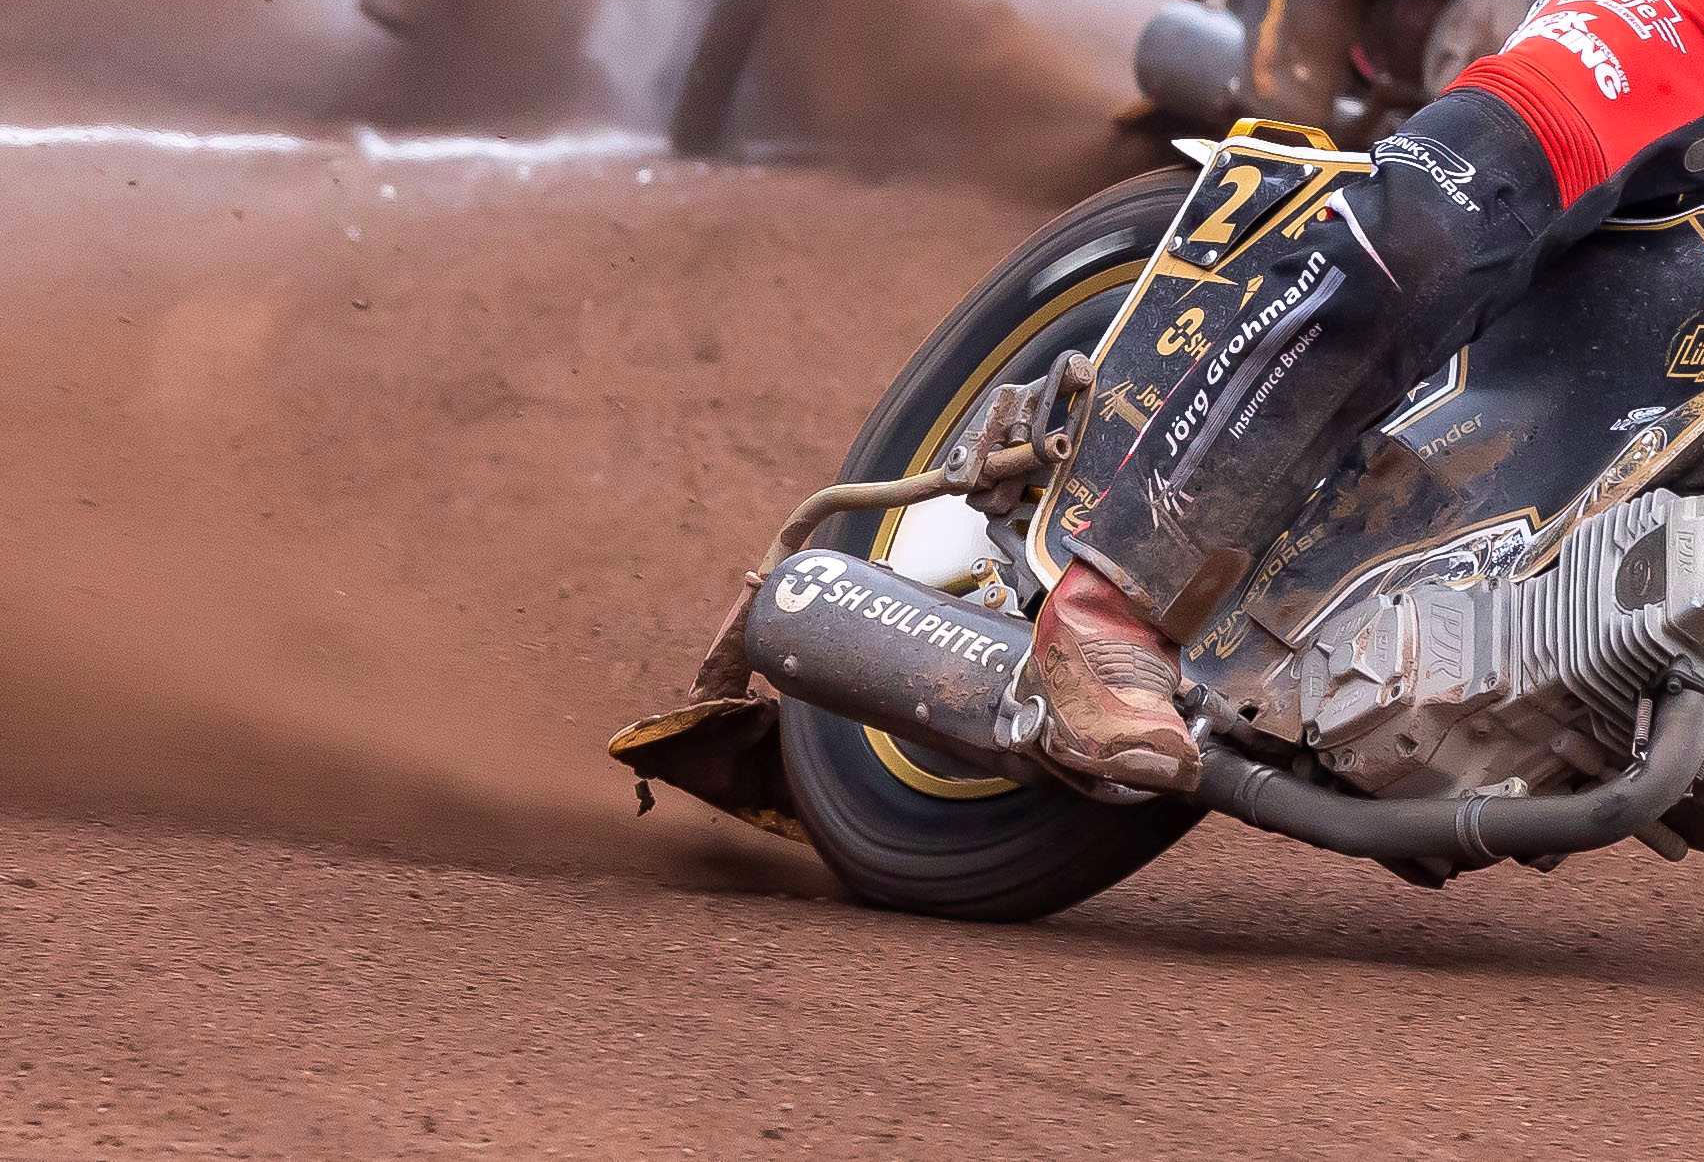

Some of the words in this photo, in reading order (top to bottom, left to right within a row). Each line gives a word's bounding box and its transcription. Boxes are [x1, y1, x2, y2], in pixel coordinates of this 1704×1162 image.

[1187, 165, 1263, 244] 2
[1164, 388, 1210, 458] Jörg
[1206, 250, 1327, 386] Grohmann
[1228, 366, 1286, 440] Insurance
[1279, 322, 1324, 370] Broker
[821, 580, 873, 612] SH
